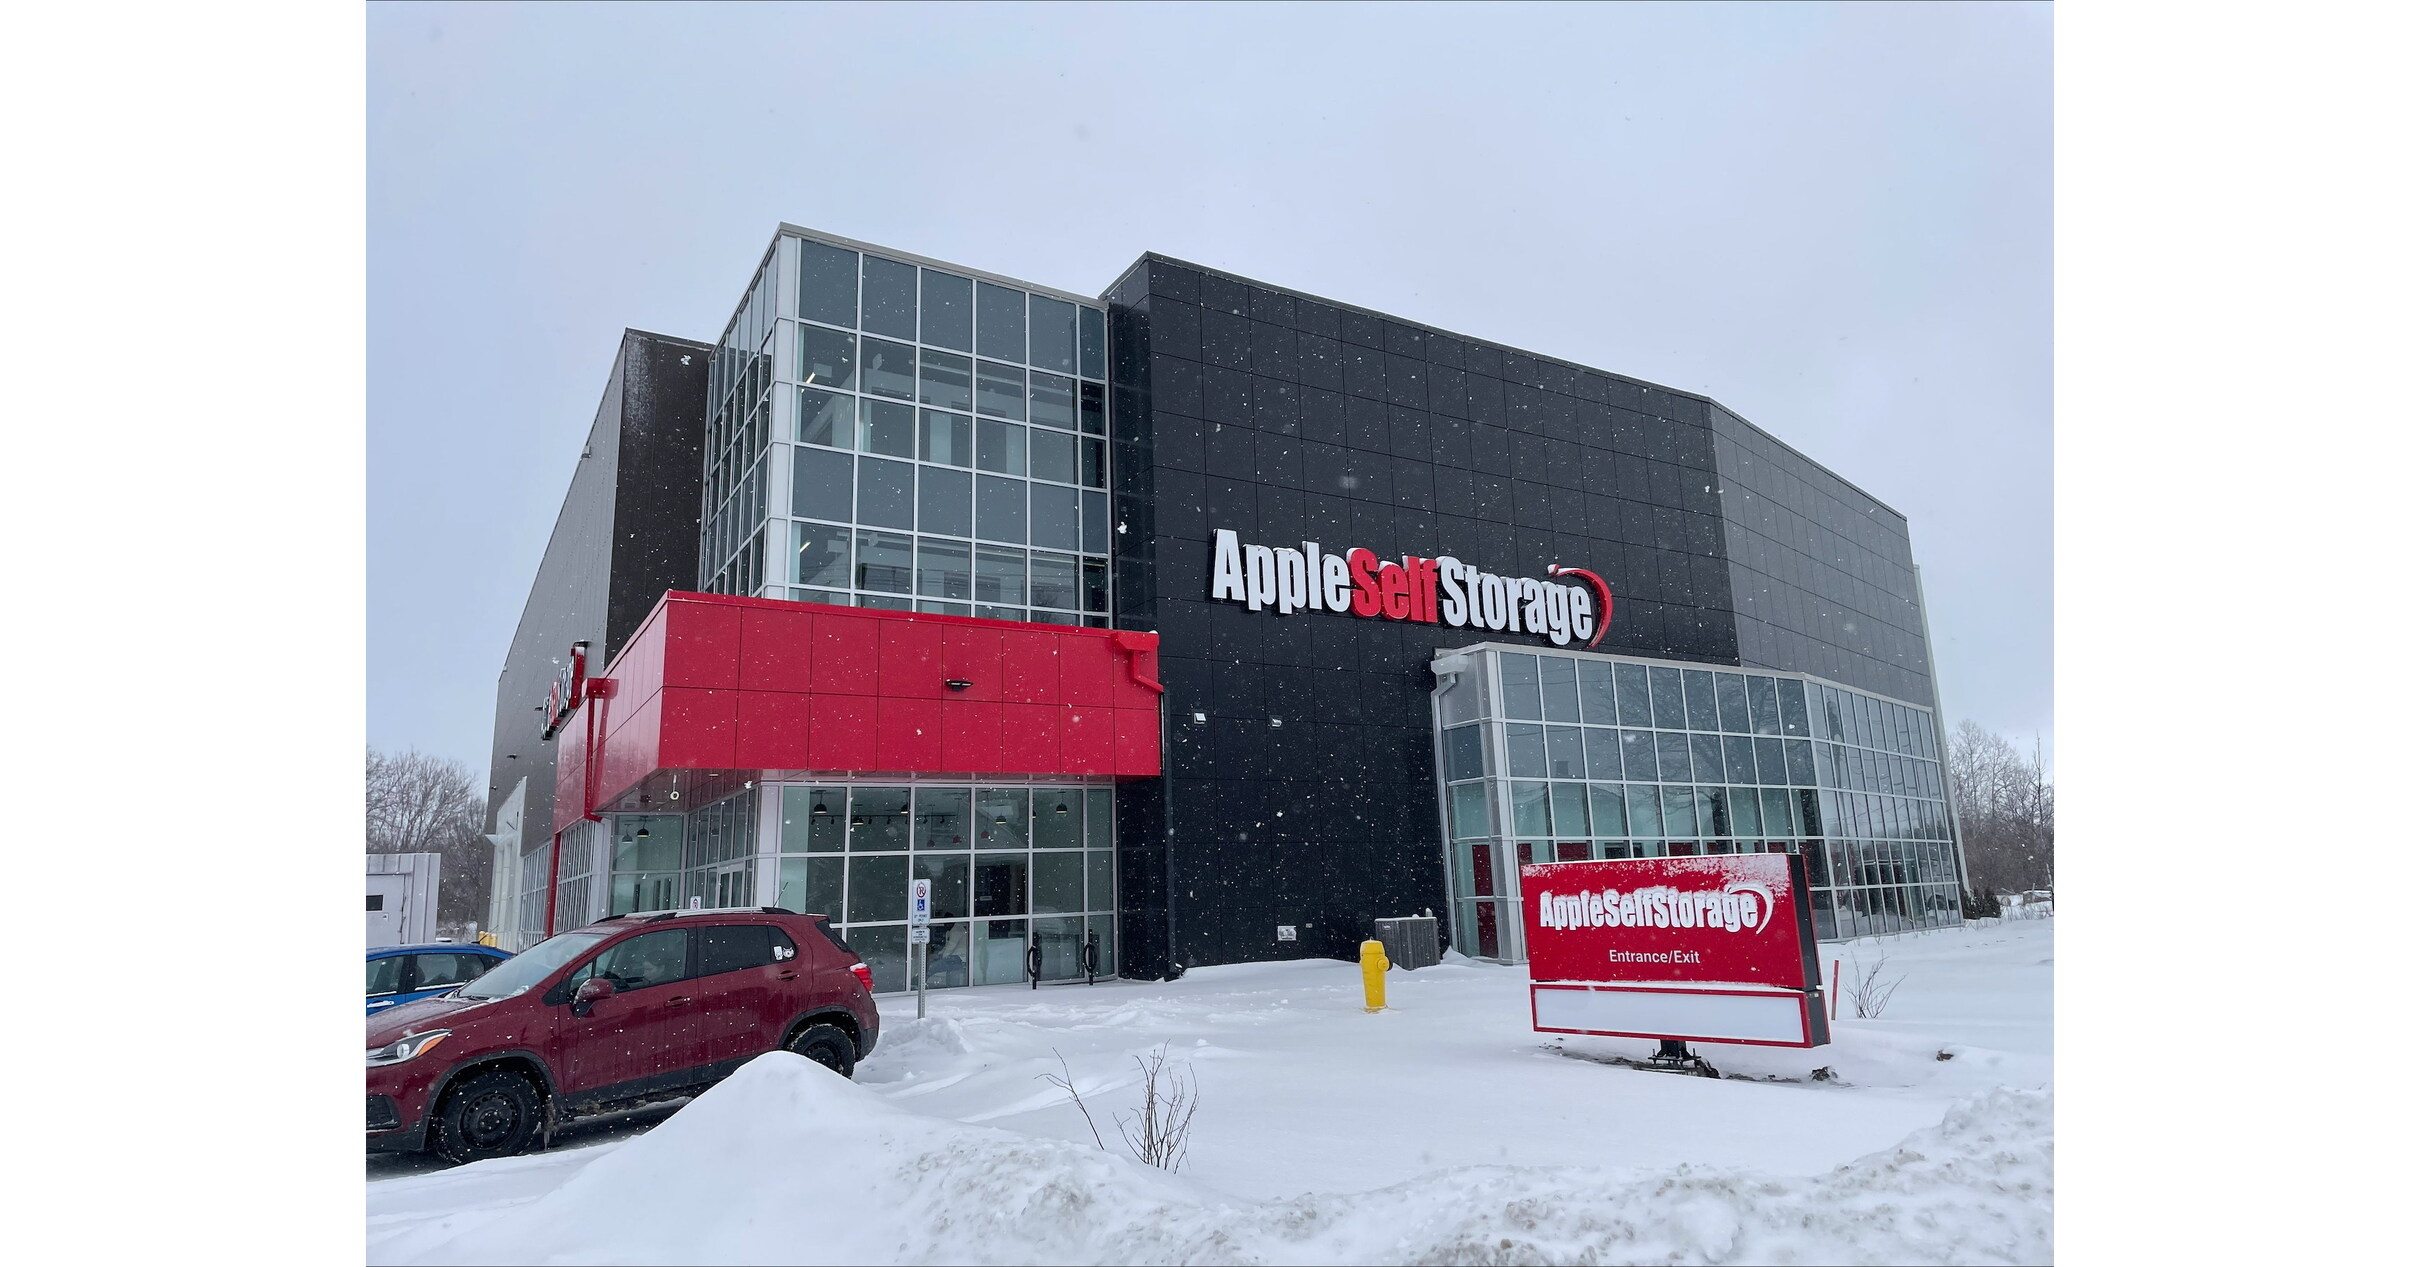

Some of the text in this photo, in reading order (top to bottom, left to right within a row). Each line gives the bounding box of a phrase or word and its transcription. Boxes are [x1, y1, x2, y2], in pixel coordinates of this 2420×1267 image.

[1212, 528, 1594, 645] AppleSelfStorage
[1540, 887, 1758, 932] AppleSelfStorage
[1609, 949, 1701, 964] Entrance/Exit
